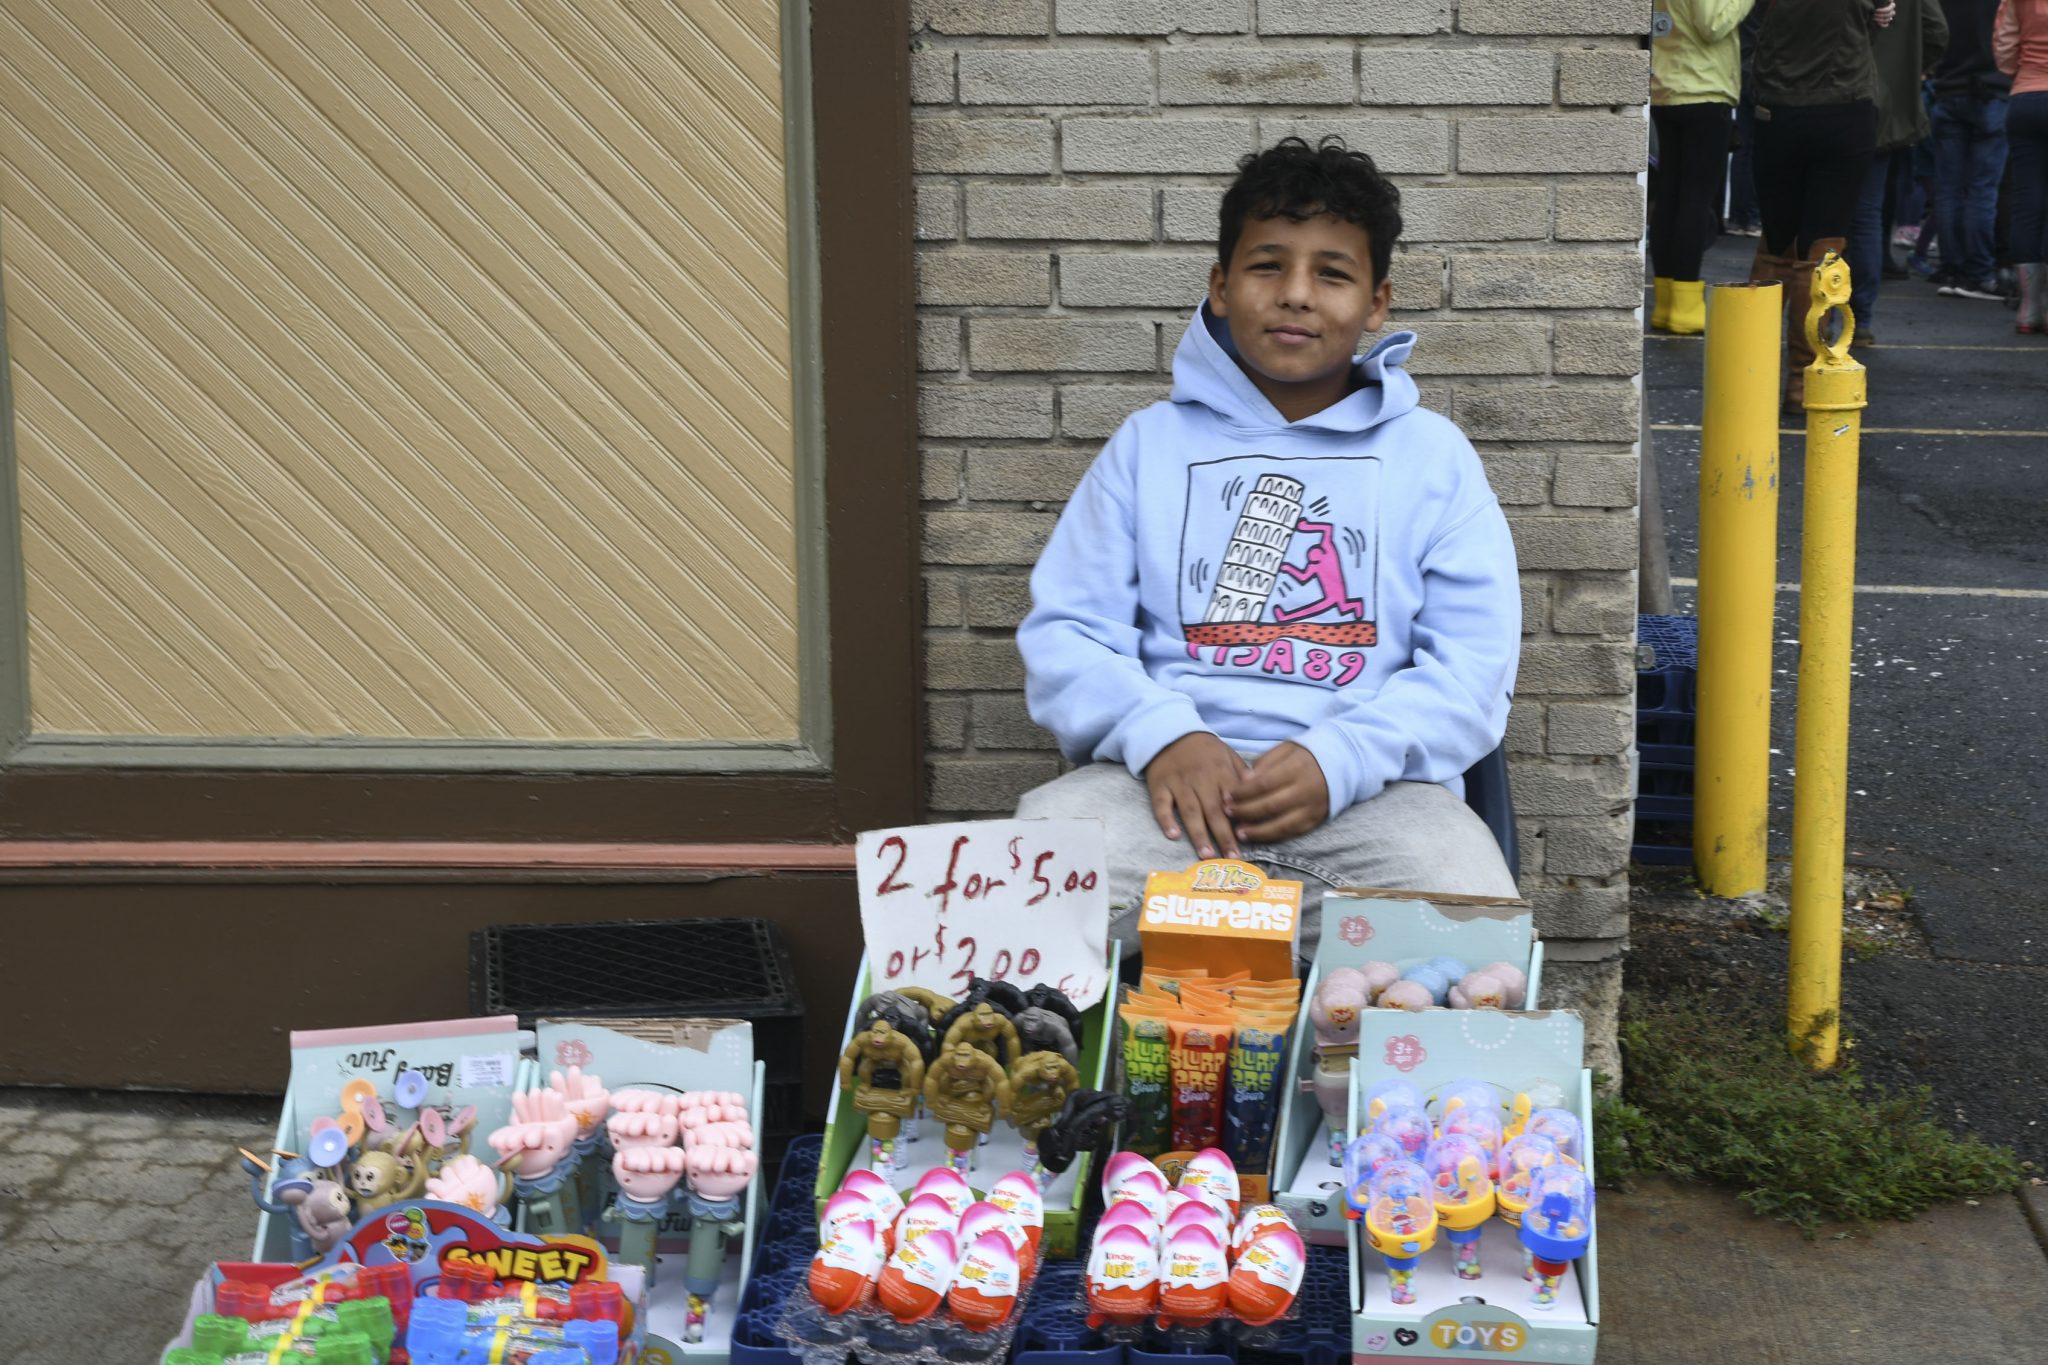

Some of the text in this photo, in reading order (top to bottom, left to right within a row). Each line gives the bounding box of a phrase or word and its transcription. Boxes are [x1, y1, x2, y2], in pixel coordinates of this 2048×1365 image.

[876, 835, 1098, 913] 2 for $5.00
[885, 945, 931, 979] or
[1438, 1324, 1519, 1347] TOYS
